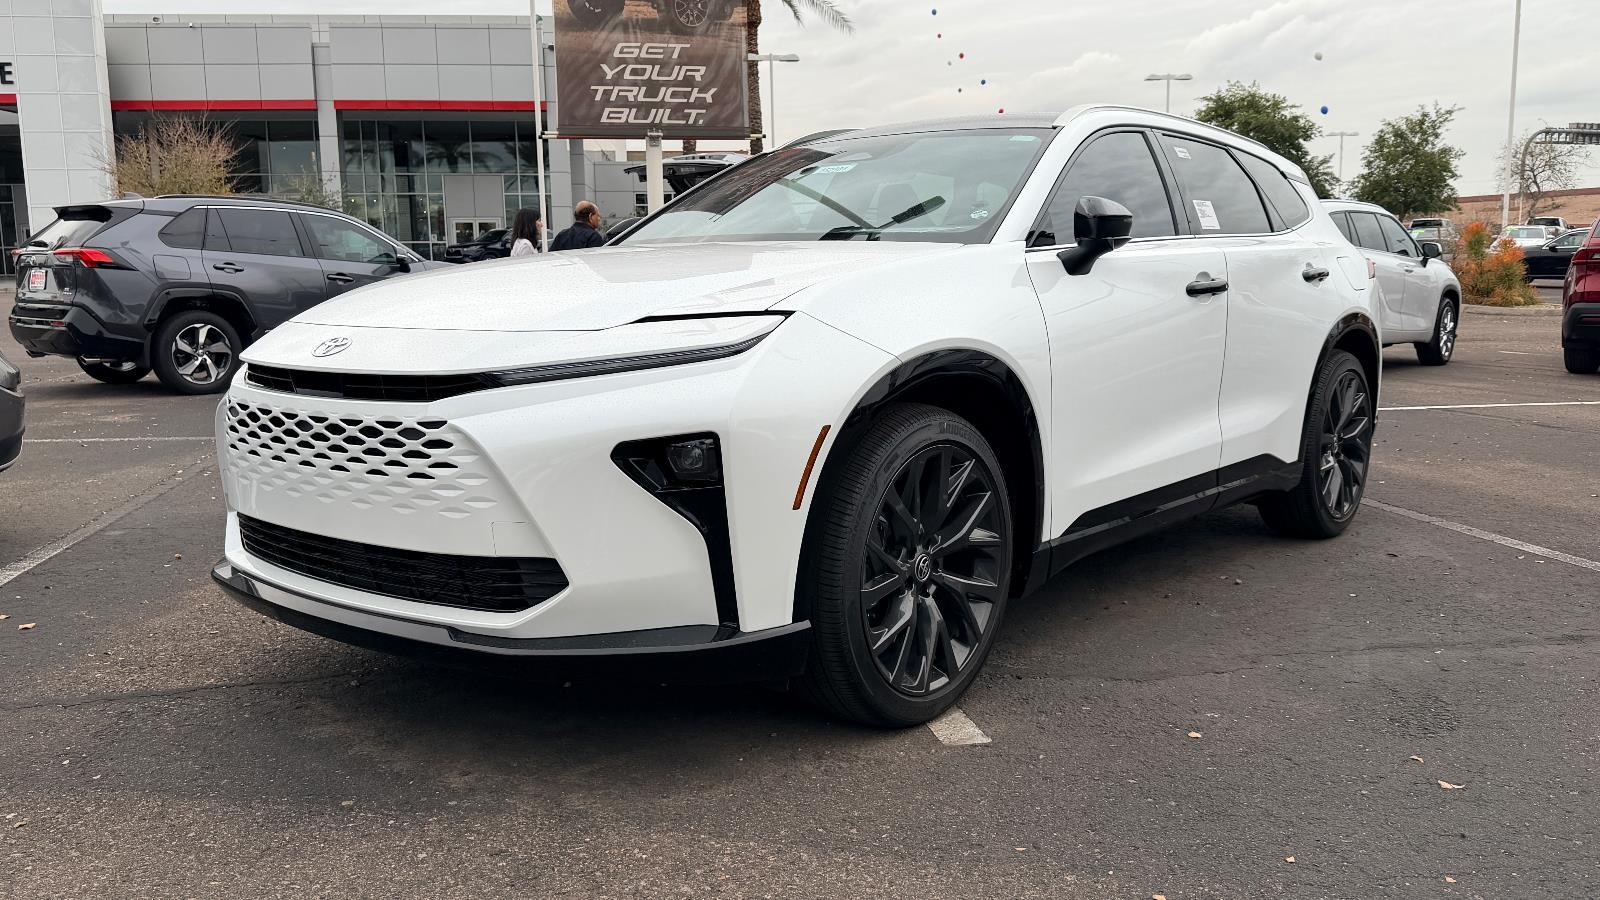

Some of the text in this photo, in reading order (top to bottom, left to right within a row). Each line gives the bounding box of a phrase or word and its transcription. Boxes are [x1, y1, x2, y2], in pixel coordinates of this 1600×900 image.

[613, 42, 691, 59] GET
[600, 63, 706, 81] YOUR
[590, 85, 718, 103] TRUCK
[600, 107, 706, 125] BUILT.
